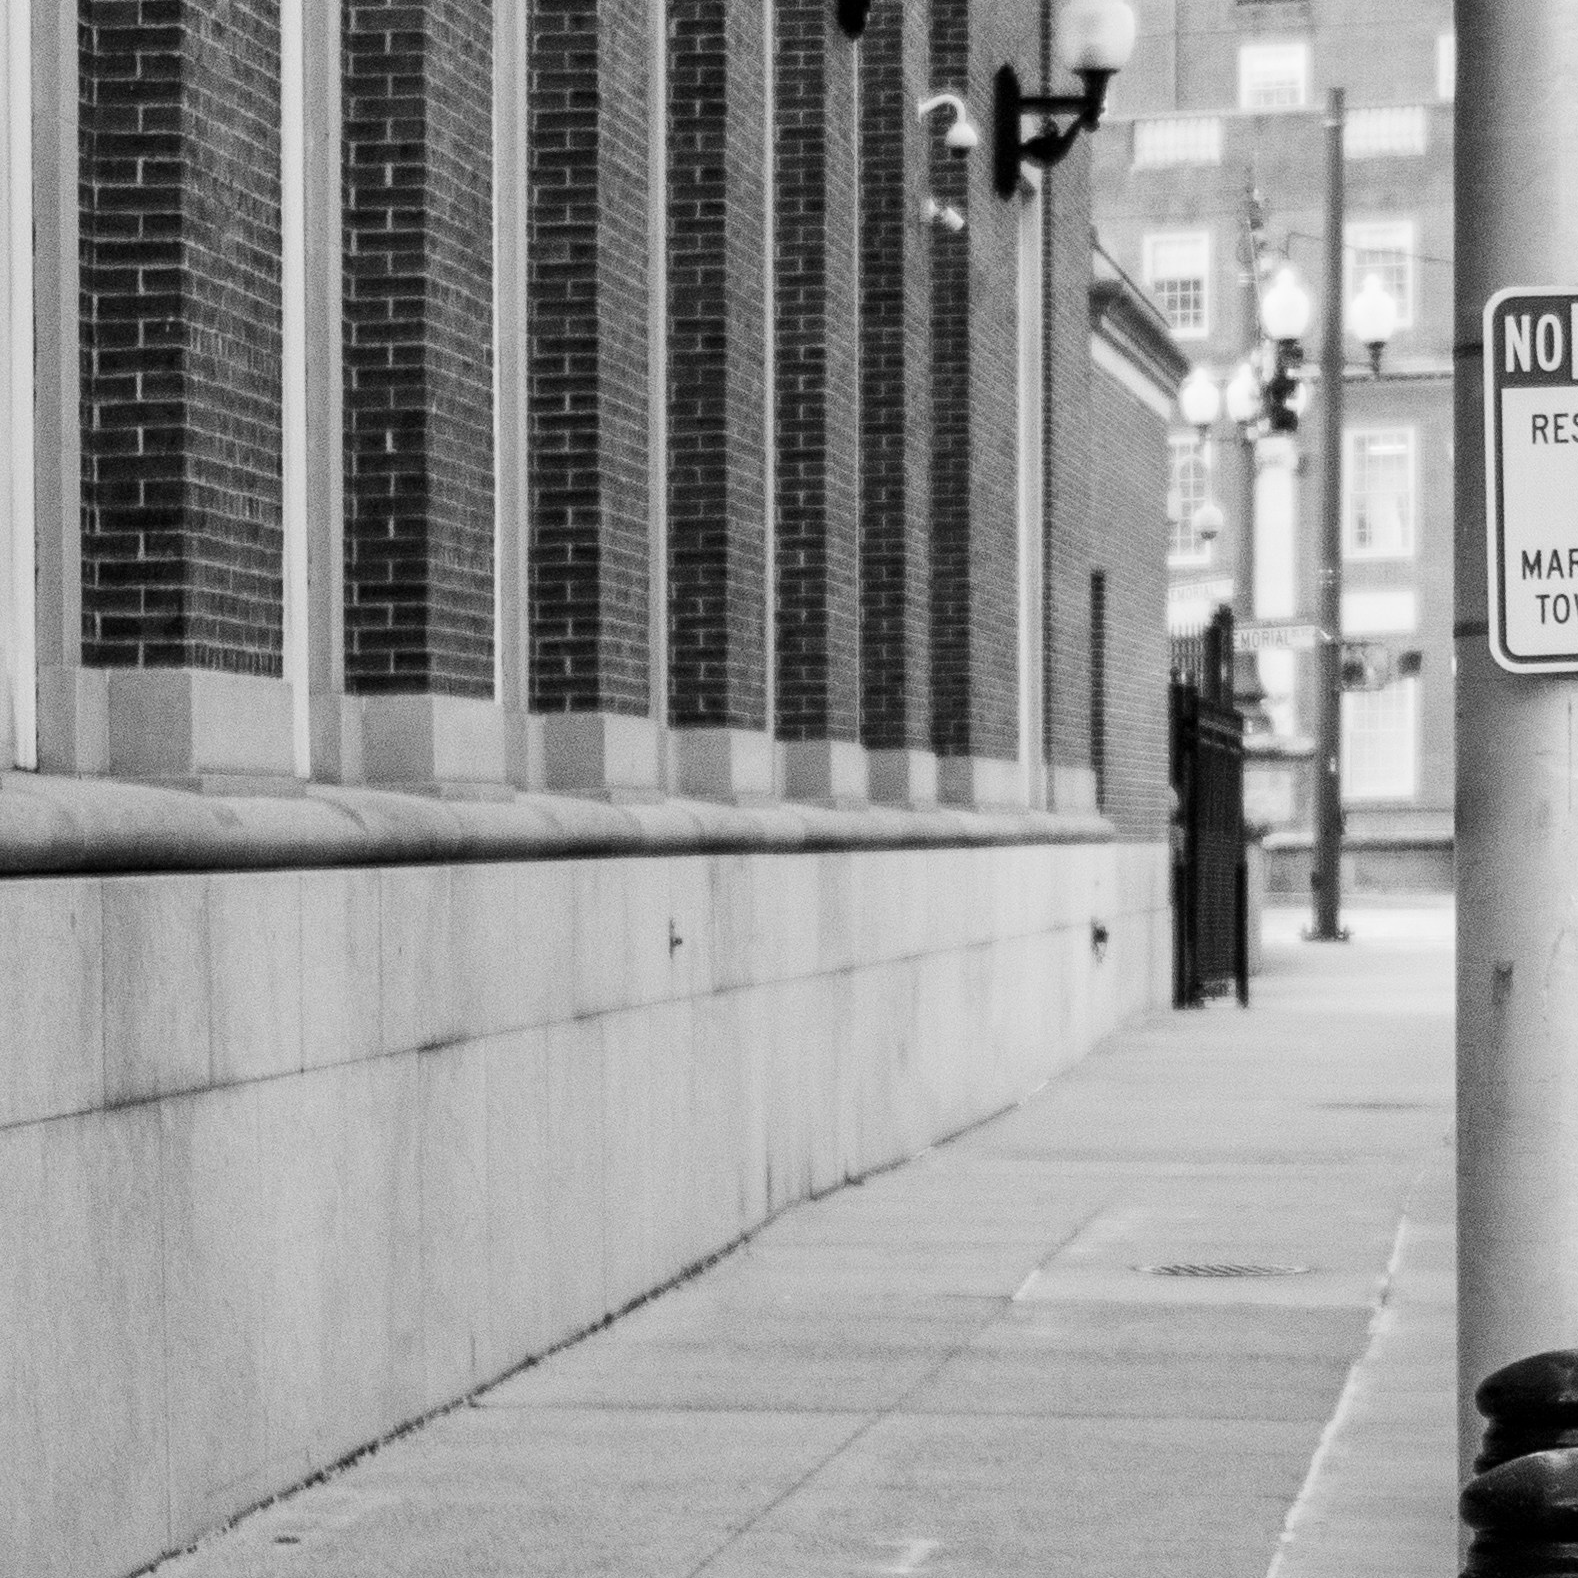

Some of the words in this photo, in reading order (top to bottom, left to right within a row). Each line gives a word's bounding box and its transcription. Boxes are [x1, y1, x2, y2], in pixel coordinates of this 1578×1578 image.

[1504, 313, 1564, 373] NO
[1170, 584, 1214, 603] EMORIAL
[1234, 628, 1291, 651] EMORIAL
